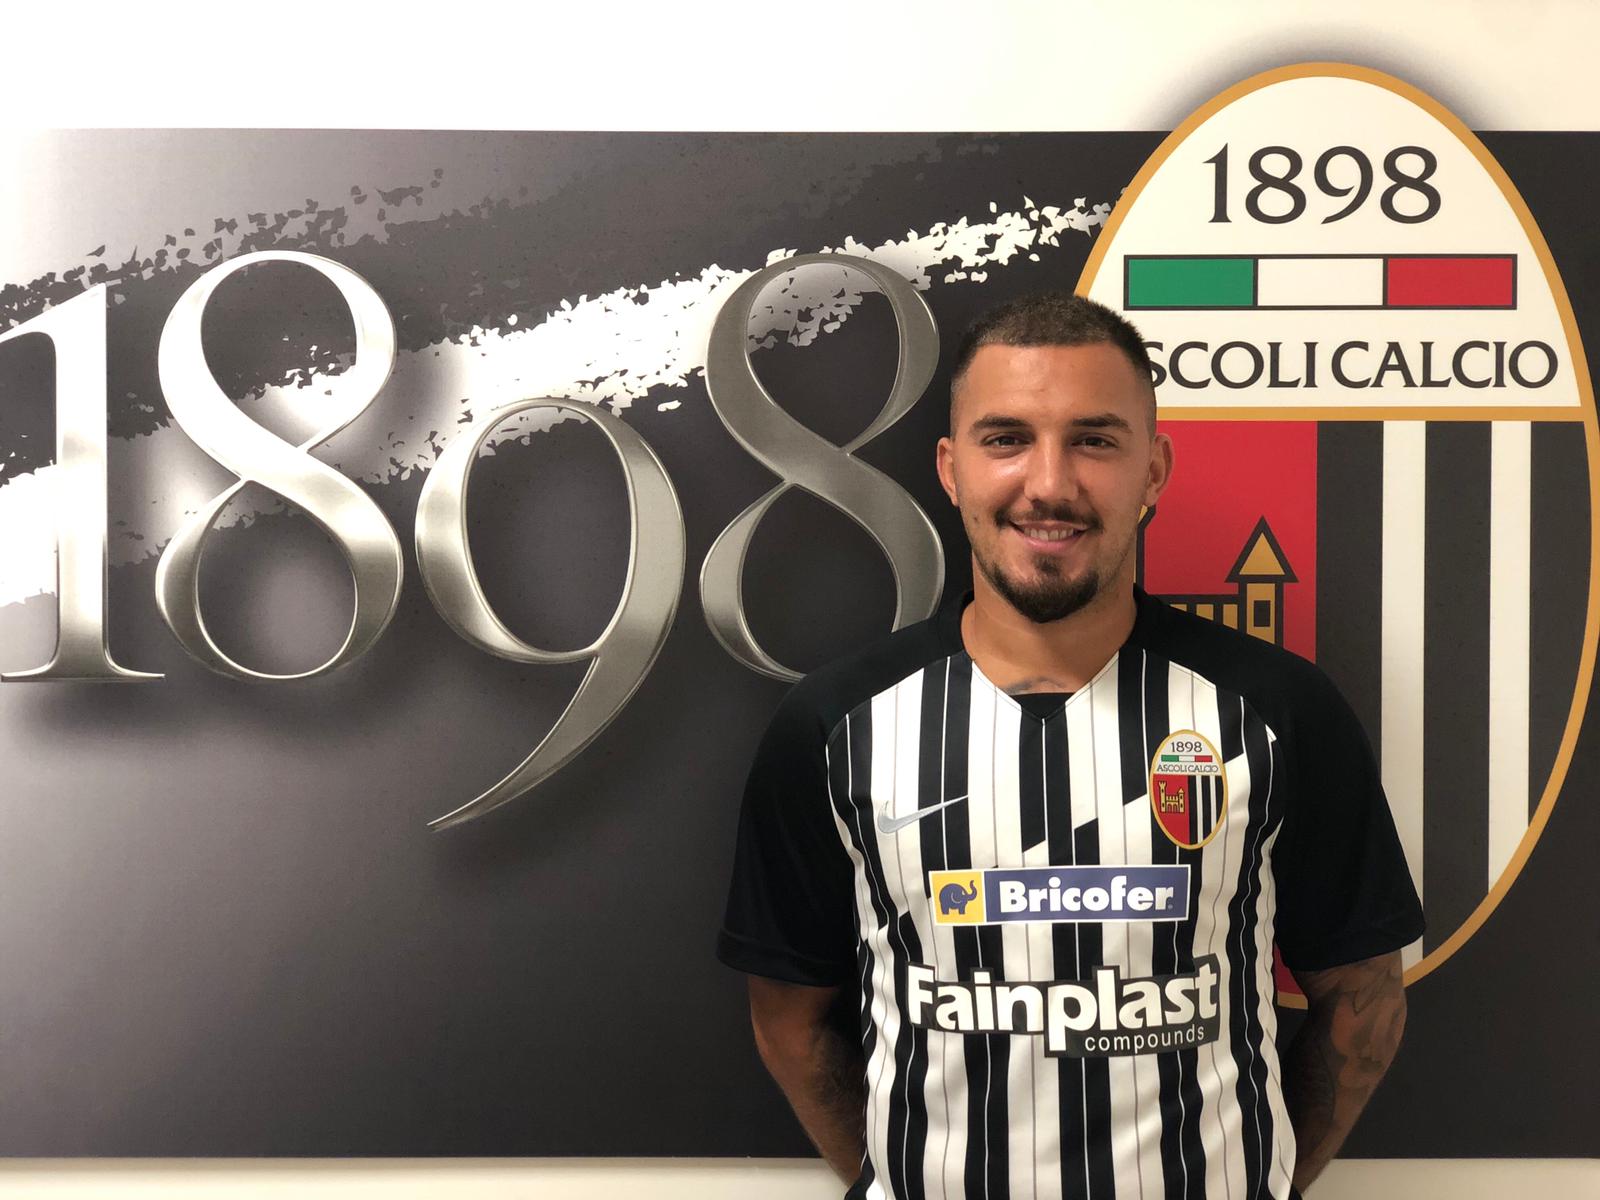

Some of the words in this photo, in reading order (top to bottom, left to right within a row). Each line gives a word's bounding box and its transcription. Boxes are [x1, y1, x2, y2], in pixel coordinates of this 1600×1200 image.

[1202, 142, 1441, 225] 1898
[1144, 340, 1318, 389] SCOLI
[1331, 340, 1559, 390] CALCIO
[0, 250, 946, 832] 1898
[1156, 764, 1188, 773] ASCOLI
[1188, 765, 1219, 773] CALCIO
[1171, 741, 1202, 753] 1898
[999, 875, 1174, 913] Bricofer
[907, 962, 1218, 1052] Fainplast
[1085, 1024, 1205, 1053] compounds
